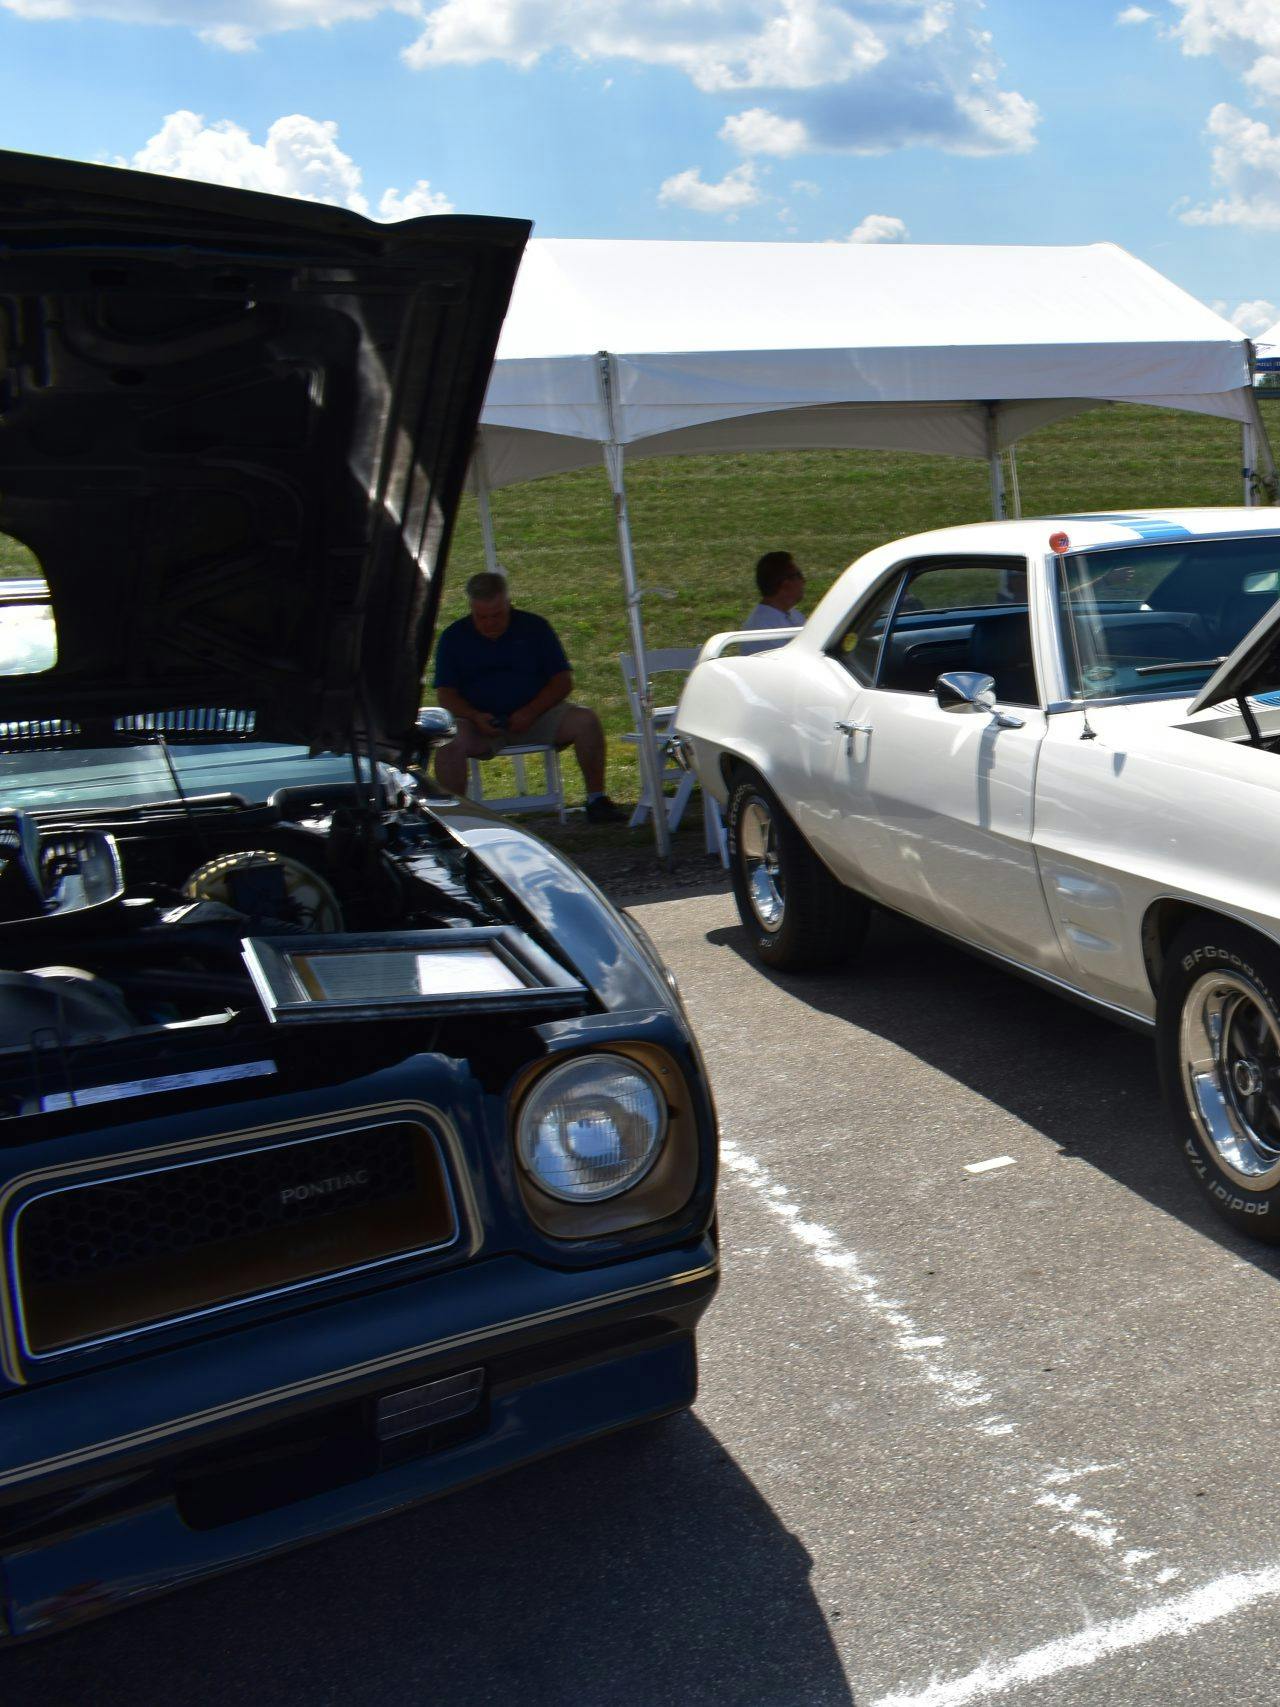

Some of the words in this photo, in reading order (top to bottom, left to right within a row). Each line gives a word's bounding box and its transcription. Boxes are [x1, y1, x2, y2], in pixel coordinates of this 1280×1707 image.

[1184, 1139, 1207, 1179] T/A
[280, 1169, 369, 1205] PONTIAC
[1209, 1181, 1269, 1215] Radial
